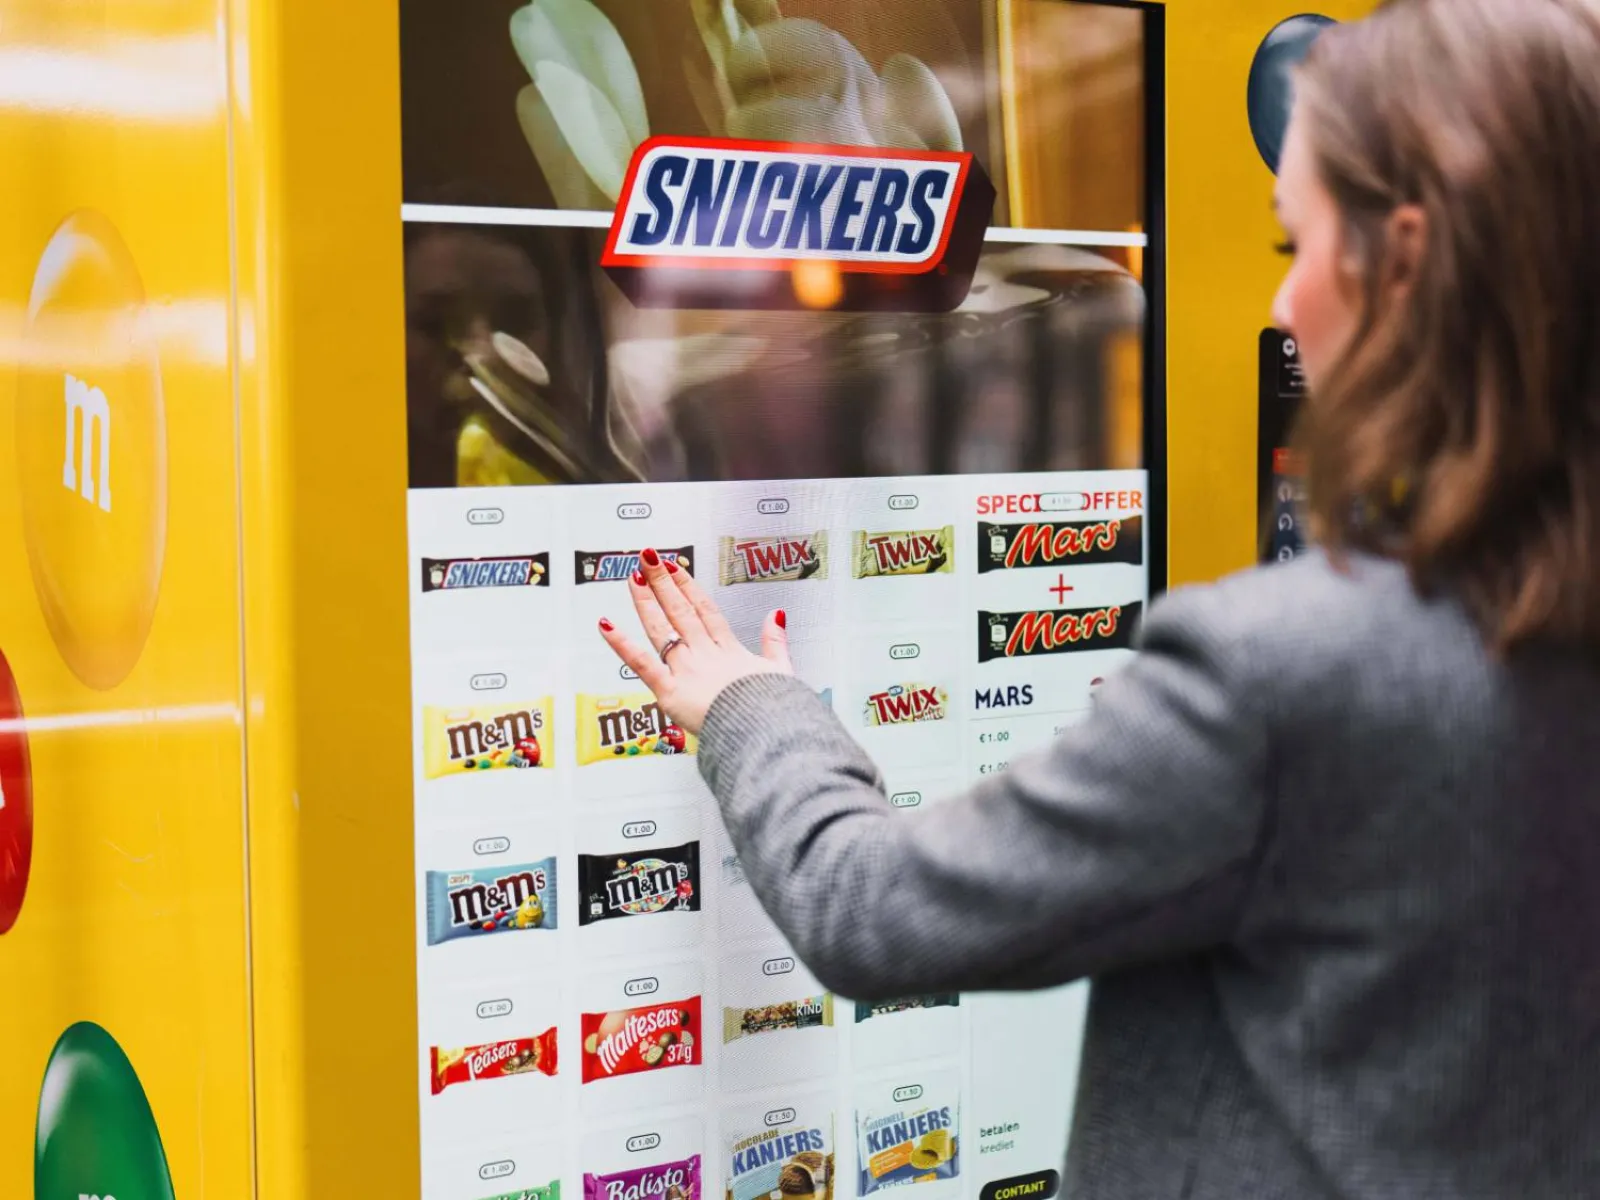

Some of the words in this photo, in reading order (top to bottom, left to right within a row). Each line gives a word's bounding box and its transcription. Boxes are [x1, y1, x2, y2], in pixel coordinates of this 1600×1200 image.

[626, 155, 950, 254] SNICKERS
[63, 372, 111, 513] m
[977, 493, 1042, 515] SPECI
[1005, 519, 1121, 568] Mars
[447, 561, 529, 586] SNICKERS
[1005, 605, 1121, 656] Mars
[975, 684, 1033, 710] MARS
[796, 1004, 823, 1017] KIND
[597, 1008, 679, 1074] Maltesers
[667, 1044, 692, 1063] 37g
[464, 1041, 517, 1081] Teasers
[867, 1106, 951, 1154] KANJERS
[980, 1122, 1020, 1138] betalen
[733, 1128, 824, 1176] KANJERS
[980, 1140, 1014, 1154] krediet
[606, 1168, 684, 1200] Balisto
[995, 1180, 1046, 1200] CONTANT
